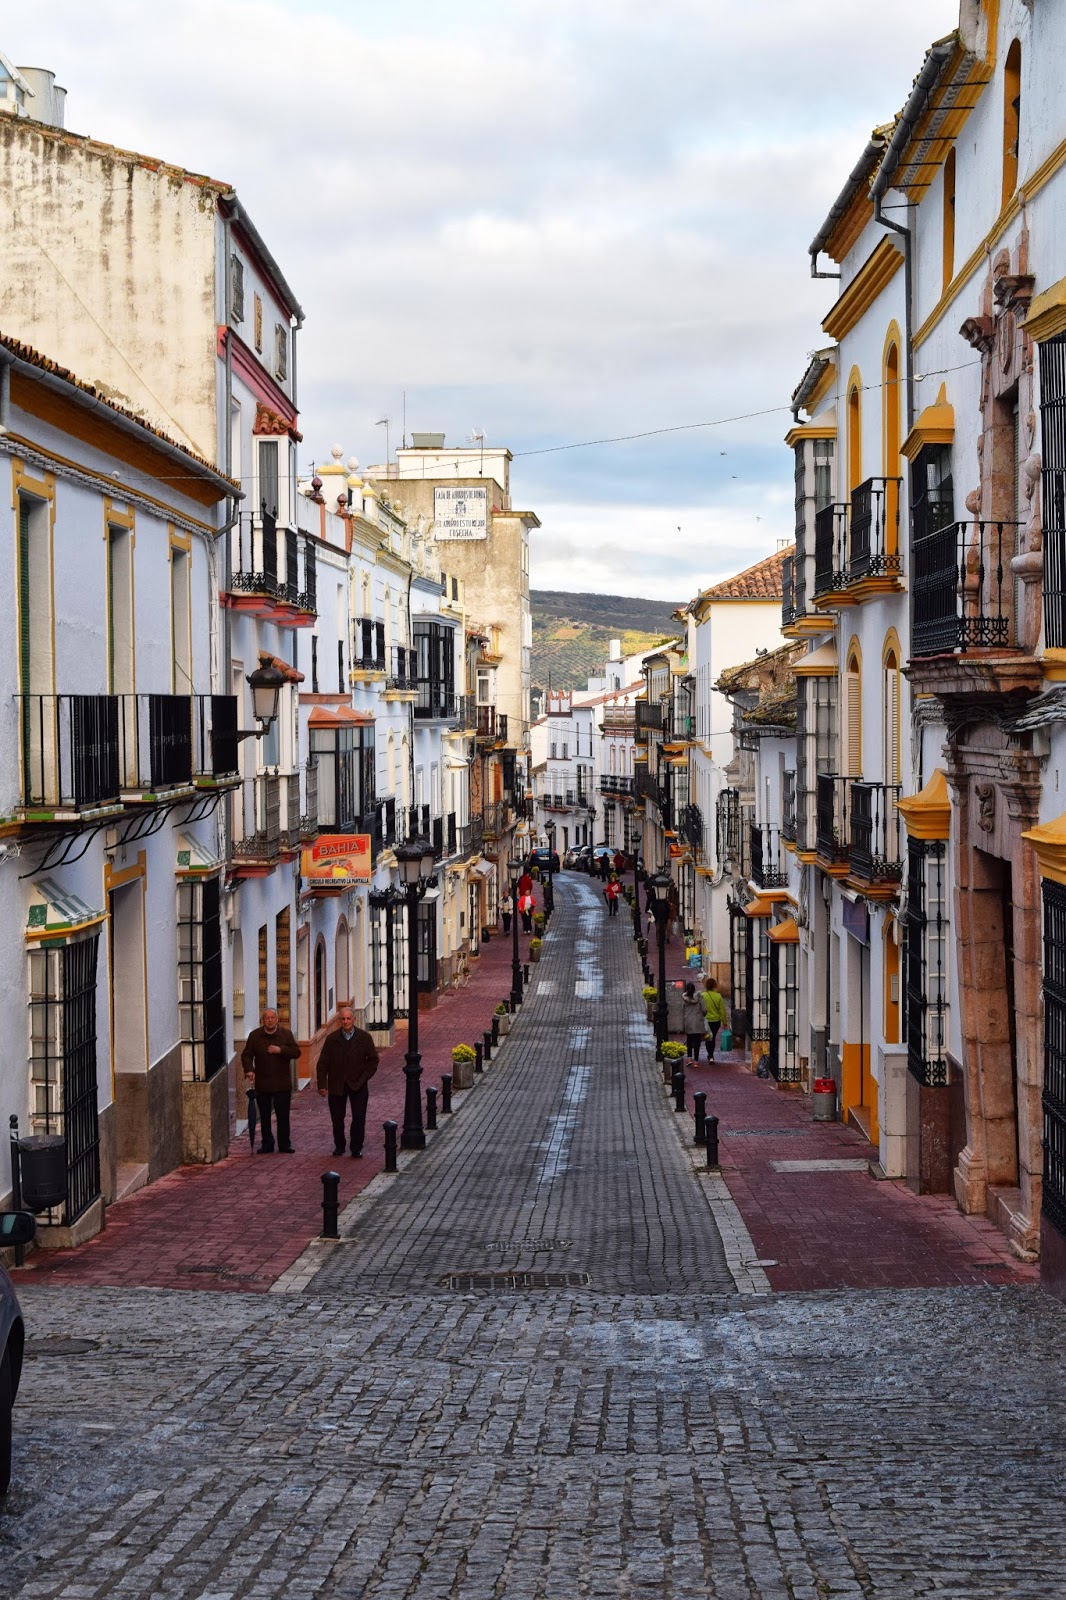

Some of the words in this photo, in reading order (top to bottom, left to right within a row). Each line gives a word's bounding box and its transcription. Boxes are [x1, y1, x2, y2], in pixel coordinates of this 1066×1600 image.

[436, 490, 446, 499] CAJA
[446, 490, 450, 499] DE
[320, 841, 359, 856] BAHIA
